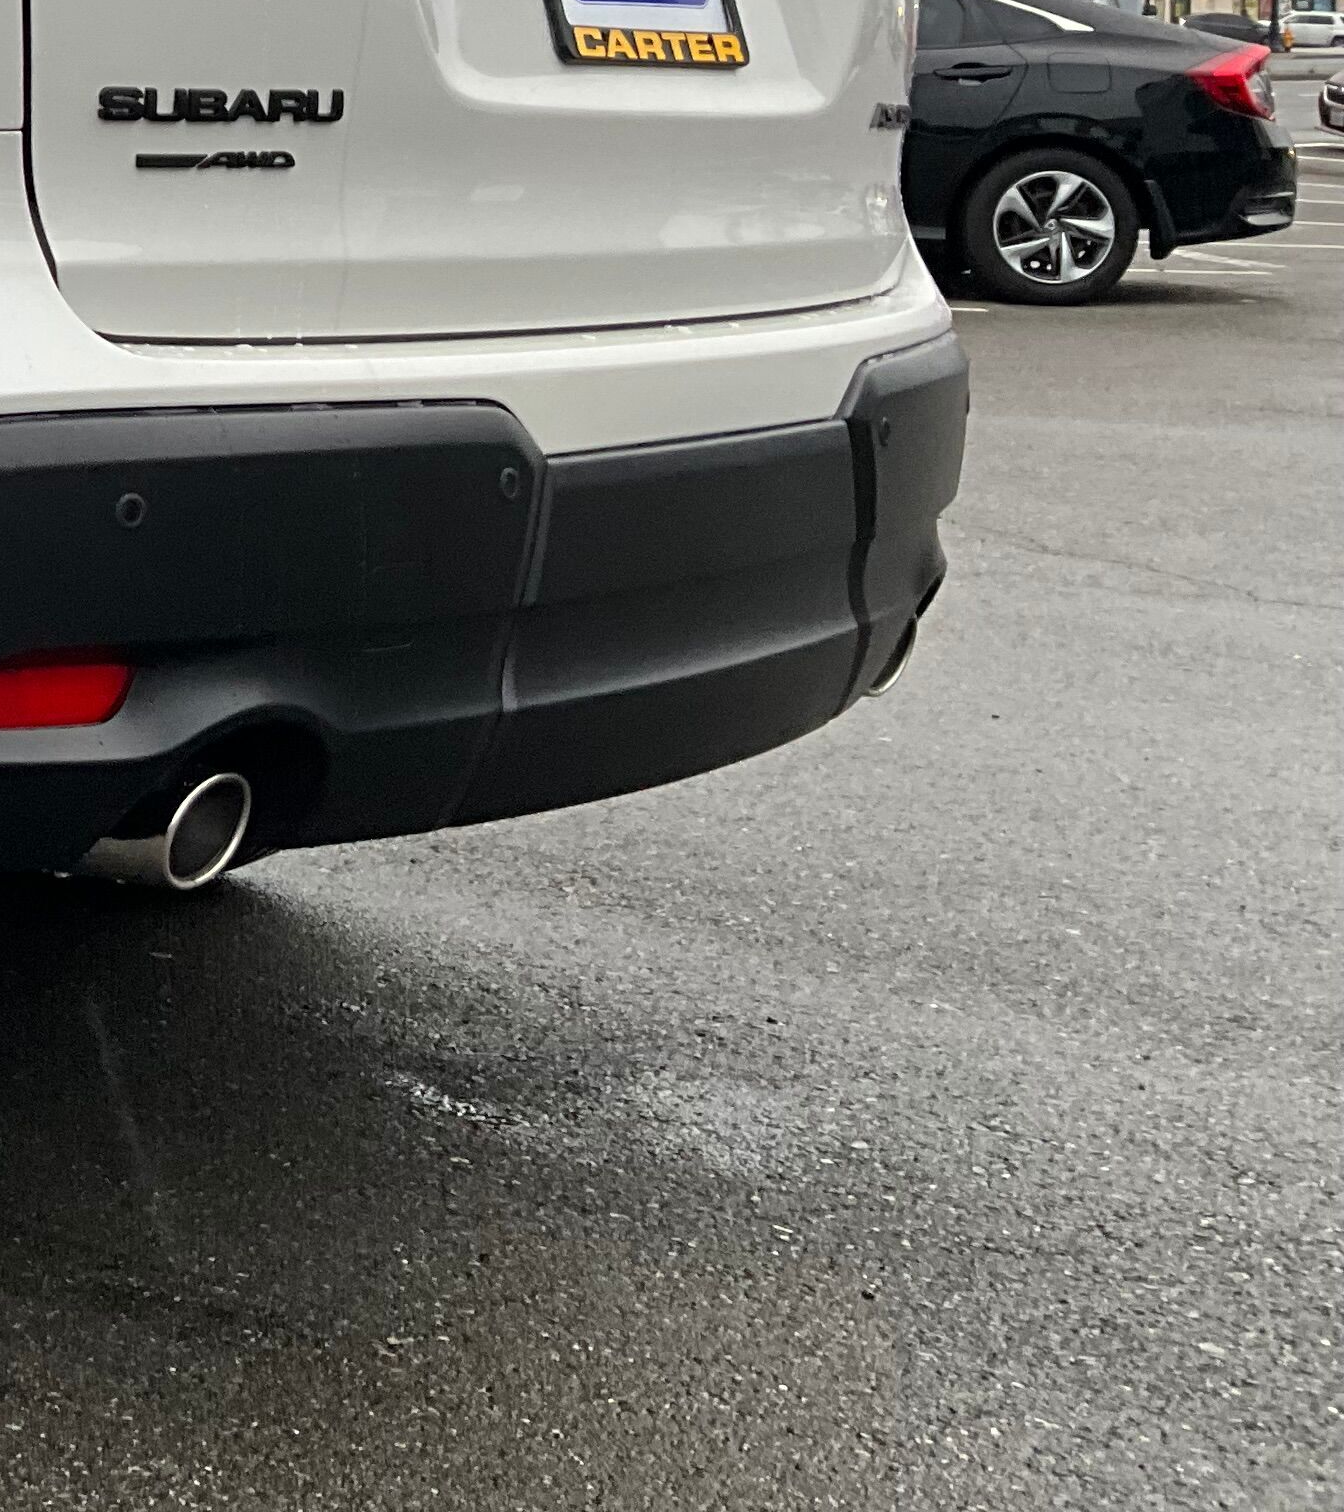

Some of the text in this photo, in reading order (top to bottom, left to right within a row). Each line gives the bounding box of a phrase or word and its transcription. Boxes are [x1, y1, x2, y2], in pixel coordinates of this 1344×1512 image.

[573, 26, 745, 63] CARTER
[97, 86, 344, 122] SUBARU
[196, 150, 296, 168] AWD
